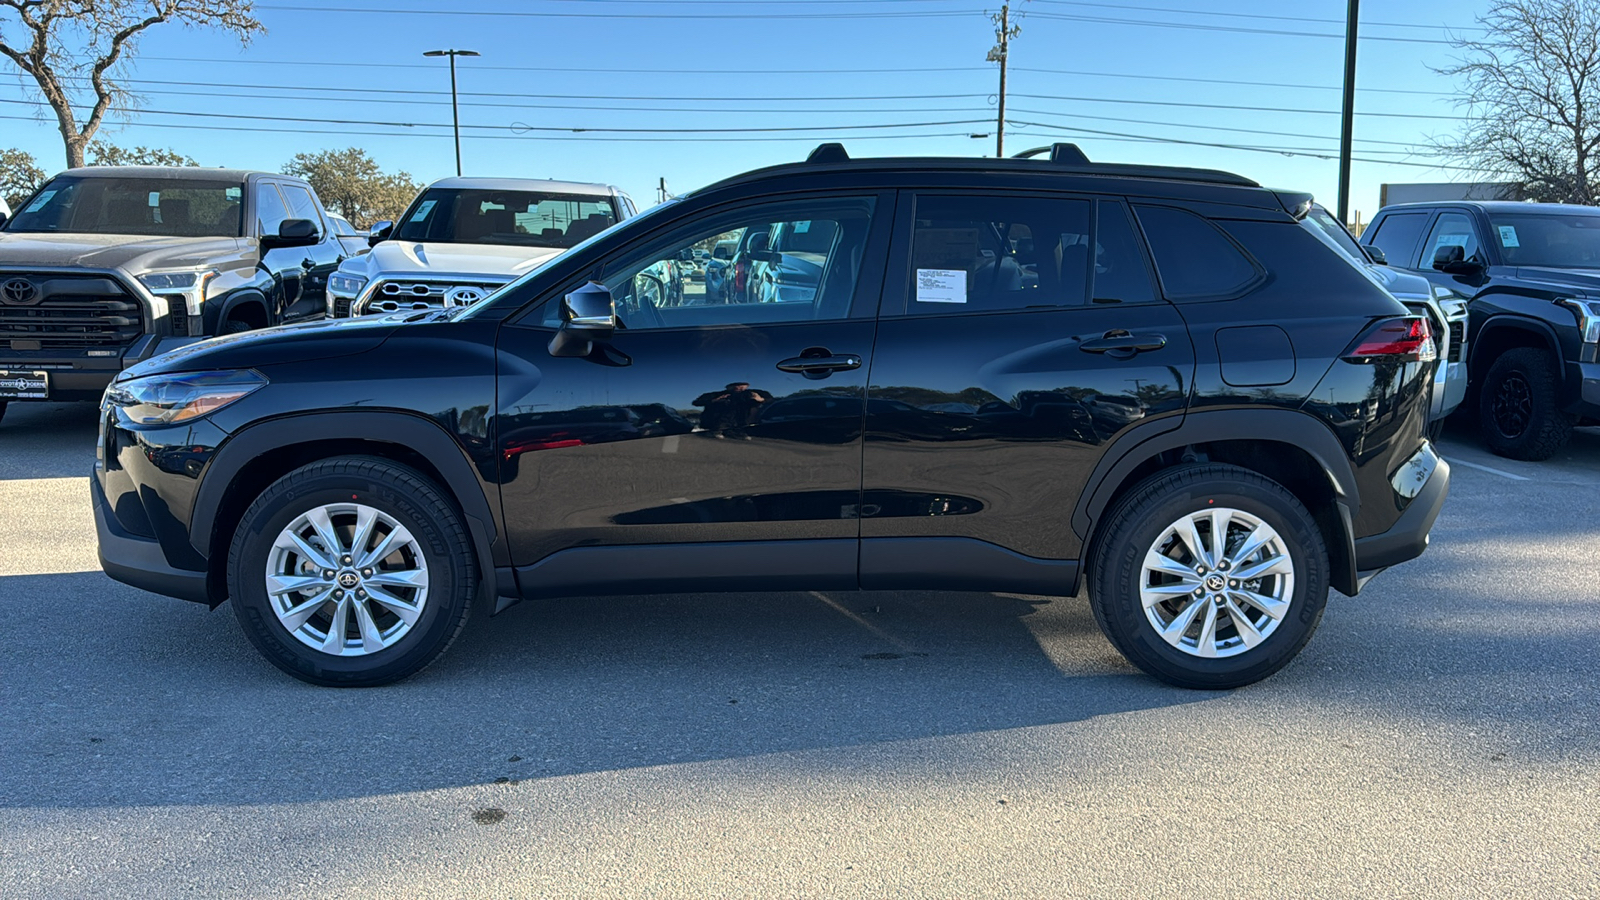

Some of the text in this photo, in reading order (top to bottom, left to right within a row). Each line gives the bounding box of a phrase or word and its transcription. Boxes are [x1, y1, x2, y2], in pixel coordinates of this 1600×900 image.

[396, 499, 446, 554] MICHELIN
[1119, 546, 1138, 612] MICHELIN
[1301, 558, 1318, 621] MICHELIN
